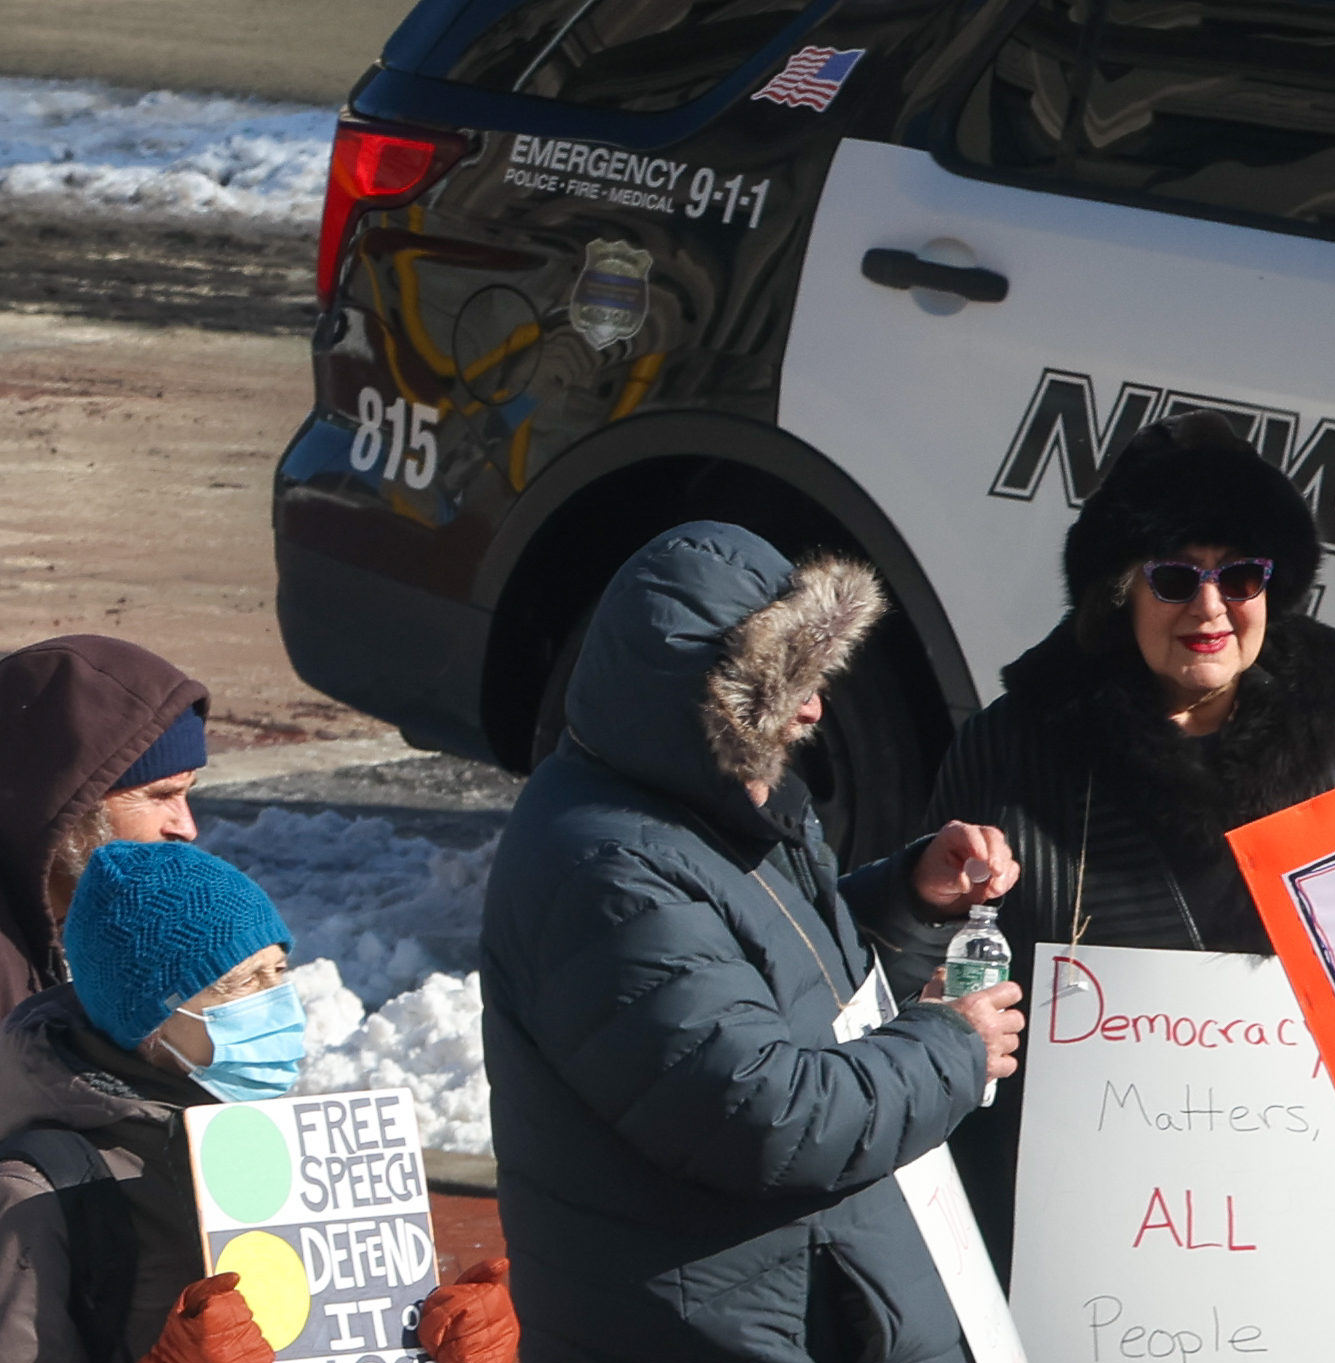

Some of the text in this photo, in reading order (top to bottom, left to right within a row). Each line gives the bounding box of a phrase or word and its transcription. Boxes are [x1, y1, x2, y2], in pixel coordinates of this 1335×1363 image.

[504, 168, 675, 213] POLICE FIRE MEDICAL
[510, 134, 687, 190] EMERGENCY
[350, 386, 438, 490] 815
[293, 1096, 406, 1157] FREE
[1098, 1080, 1320, 1141] Matters,
[300, 1152, 423, 1212] SPEECH
[1133, 1188, 1256, 1251] ALL
[324, 1297, 392, 1350] IT
